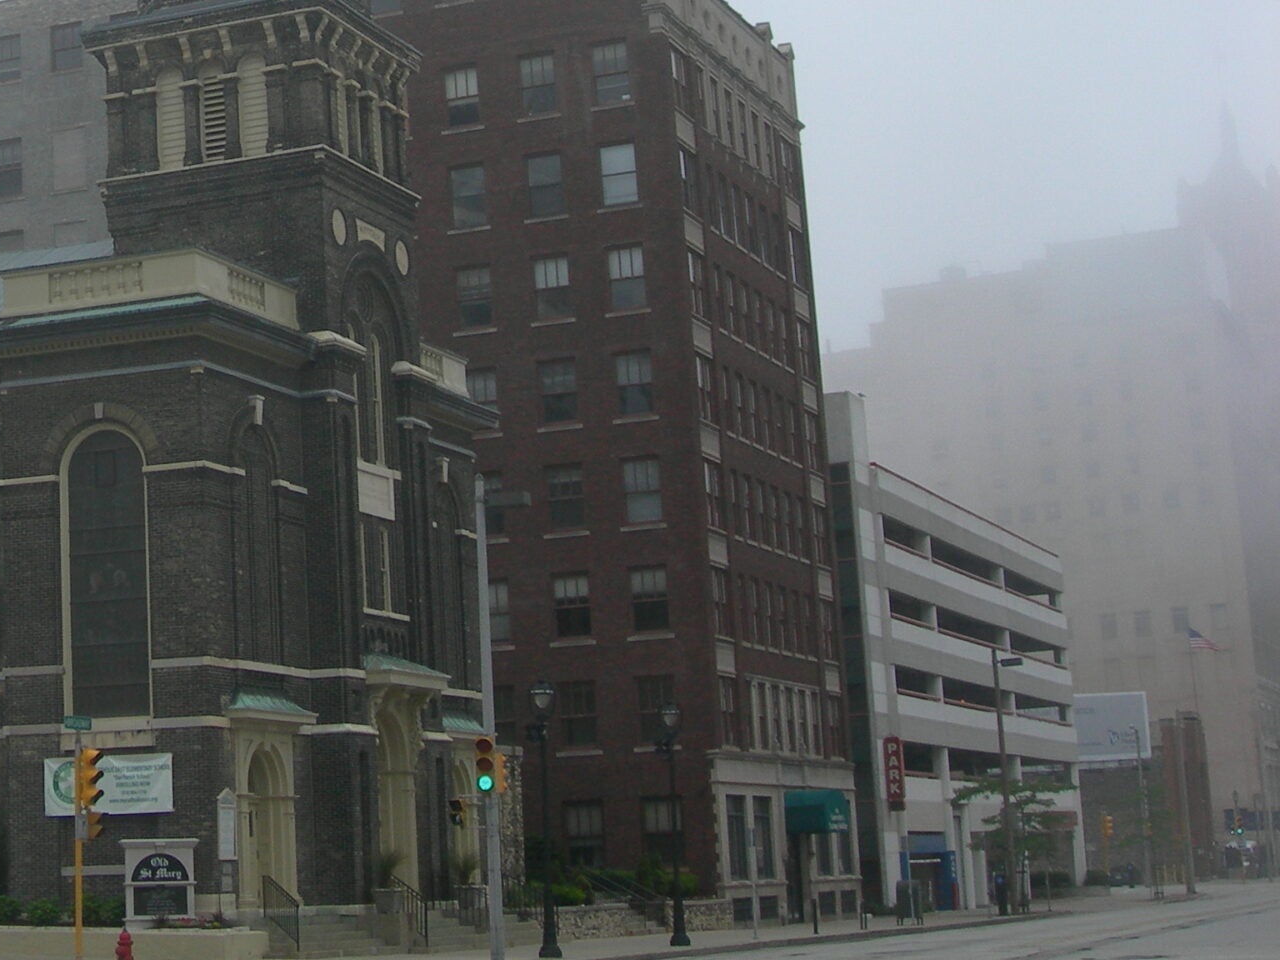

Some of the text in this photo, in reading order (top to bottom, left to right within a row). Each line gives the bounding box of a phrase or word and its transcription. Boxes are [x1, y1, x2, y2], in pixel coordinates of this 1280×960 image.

[887, 743, 900, 793] PARK
[150, 857, 169, 868] Old
[155, 868, 182, 879] Mary
